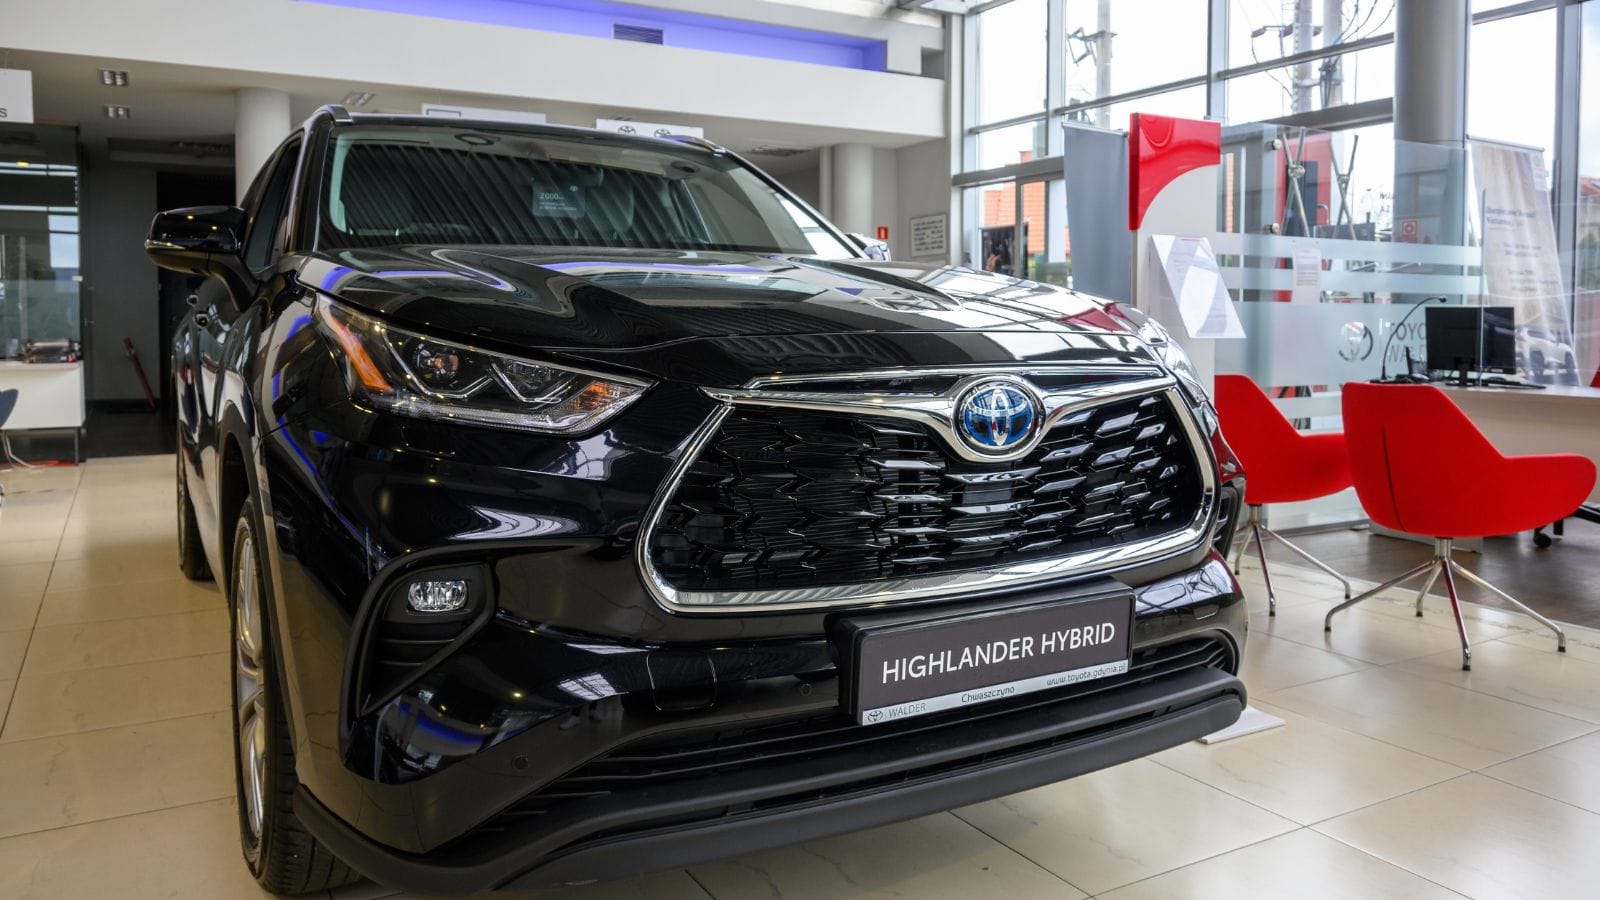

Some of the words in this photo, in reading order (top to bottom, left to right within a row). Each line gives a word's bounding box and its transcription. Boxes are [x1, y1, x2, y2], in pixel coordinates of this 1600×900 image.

[882, 636, 1034, 684] HIGHLANDER
[1041, 622, 1115, 655] HYBRID
[1047, 663, 1126, 686] www.toyota.gdynia.pl
[961, 686, 1015, 703] Chwaszczyno
[888, 702, 926, 718] WALDER
